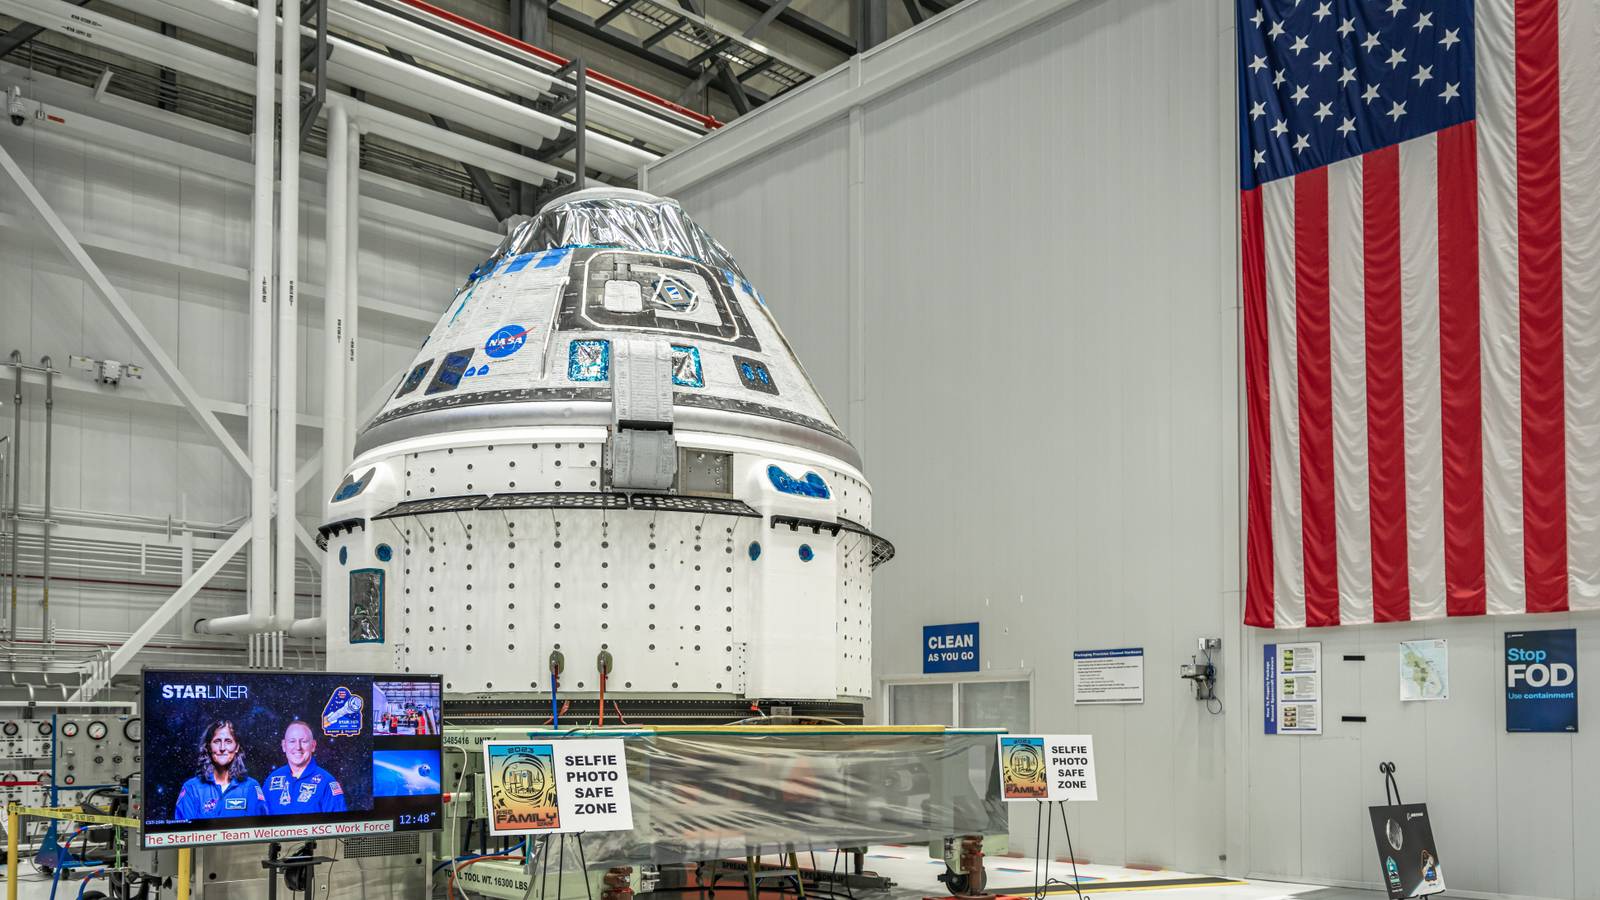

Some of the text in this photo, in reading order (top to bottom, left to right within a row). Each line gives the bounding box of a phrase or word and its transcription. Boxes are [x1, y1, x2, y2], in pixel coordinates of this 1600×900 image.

[489, 336, 523, 347] NASA
[928, 634, 974, 650] CLEAN
[928, 651, 975, 662] AS YOU GO
[1507, 648, 1547, 664] Stop
[1507, 662, 1575, 688] FOD
[162, 684, 248, 699] STARLINER
[1508, 692, 1575, 700] Use containment
[508, 746, 534, 754] 2023
[1051, 745, 1088, 754] SELFIE
[565, 755, 617, 766] SELFIE
[1052, 757, 1088, 766] PHOTO
[566, 770, 618, 783] PHOTO
[1058, 769, 1085, 777] SAFE
[1057, 780, 1087, 789] ZONE
[575, 787, 614, 799] SAFE
[575, 803, 617, 815] ZONE
[400, 814, 430, 825] 12:48
[496, 812, 557, 824] FAMILY
[167, 833, 217, 844] Starliner
[220, 831, 250, 841] Team
[253, 828, 308, 838] Welcomes
[311, 825, 332, 834] KSC
[335, 824, 360, 833] Work
[363, 823, 390, 832] Force
[464, 872, 480, 883] TOOL
[481, 875, 493, 885] WT.
[494, 878, 514, 889] 16300
[514, 881, 528, 891] LBS
